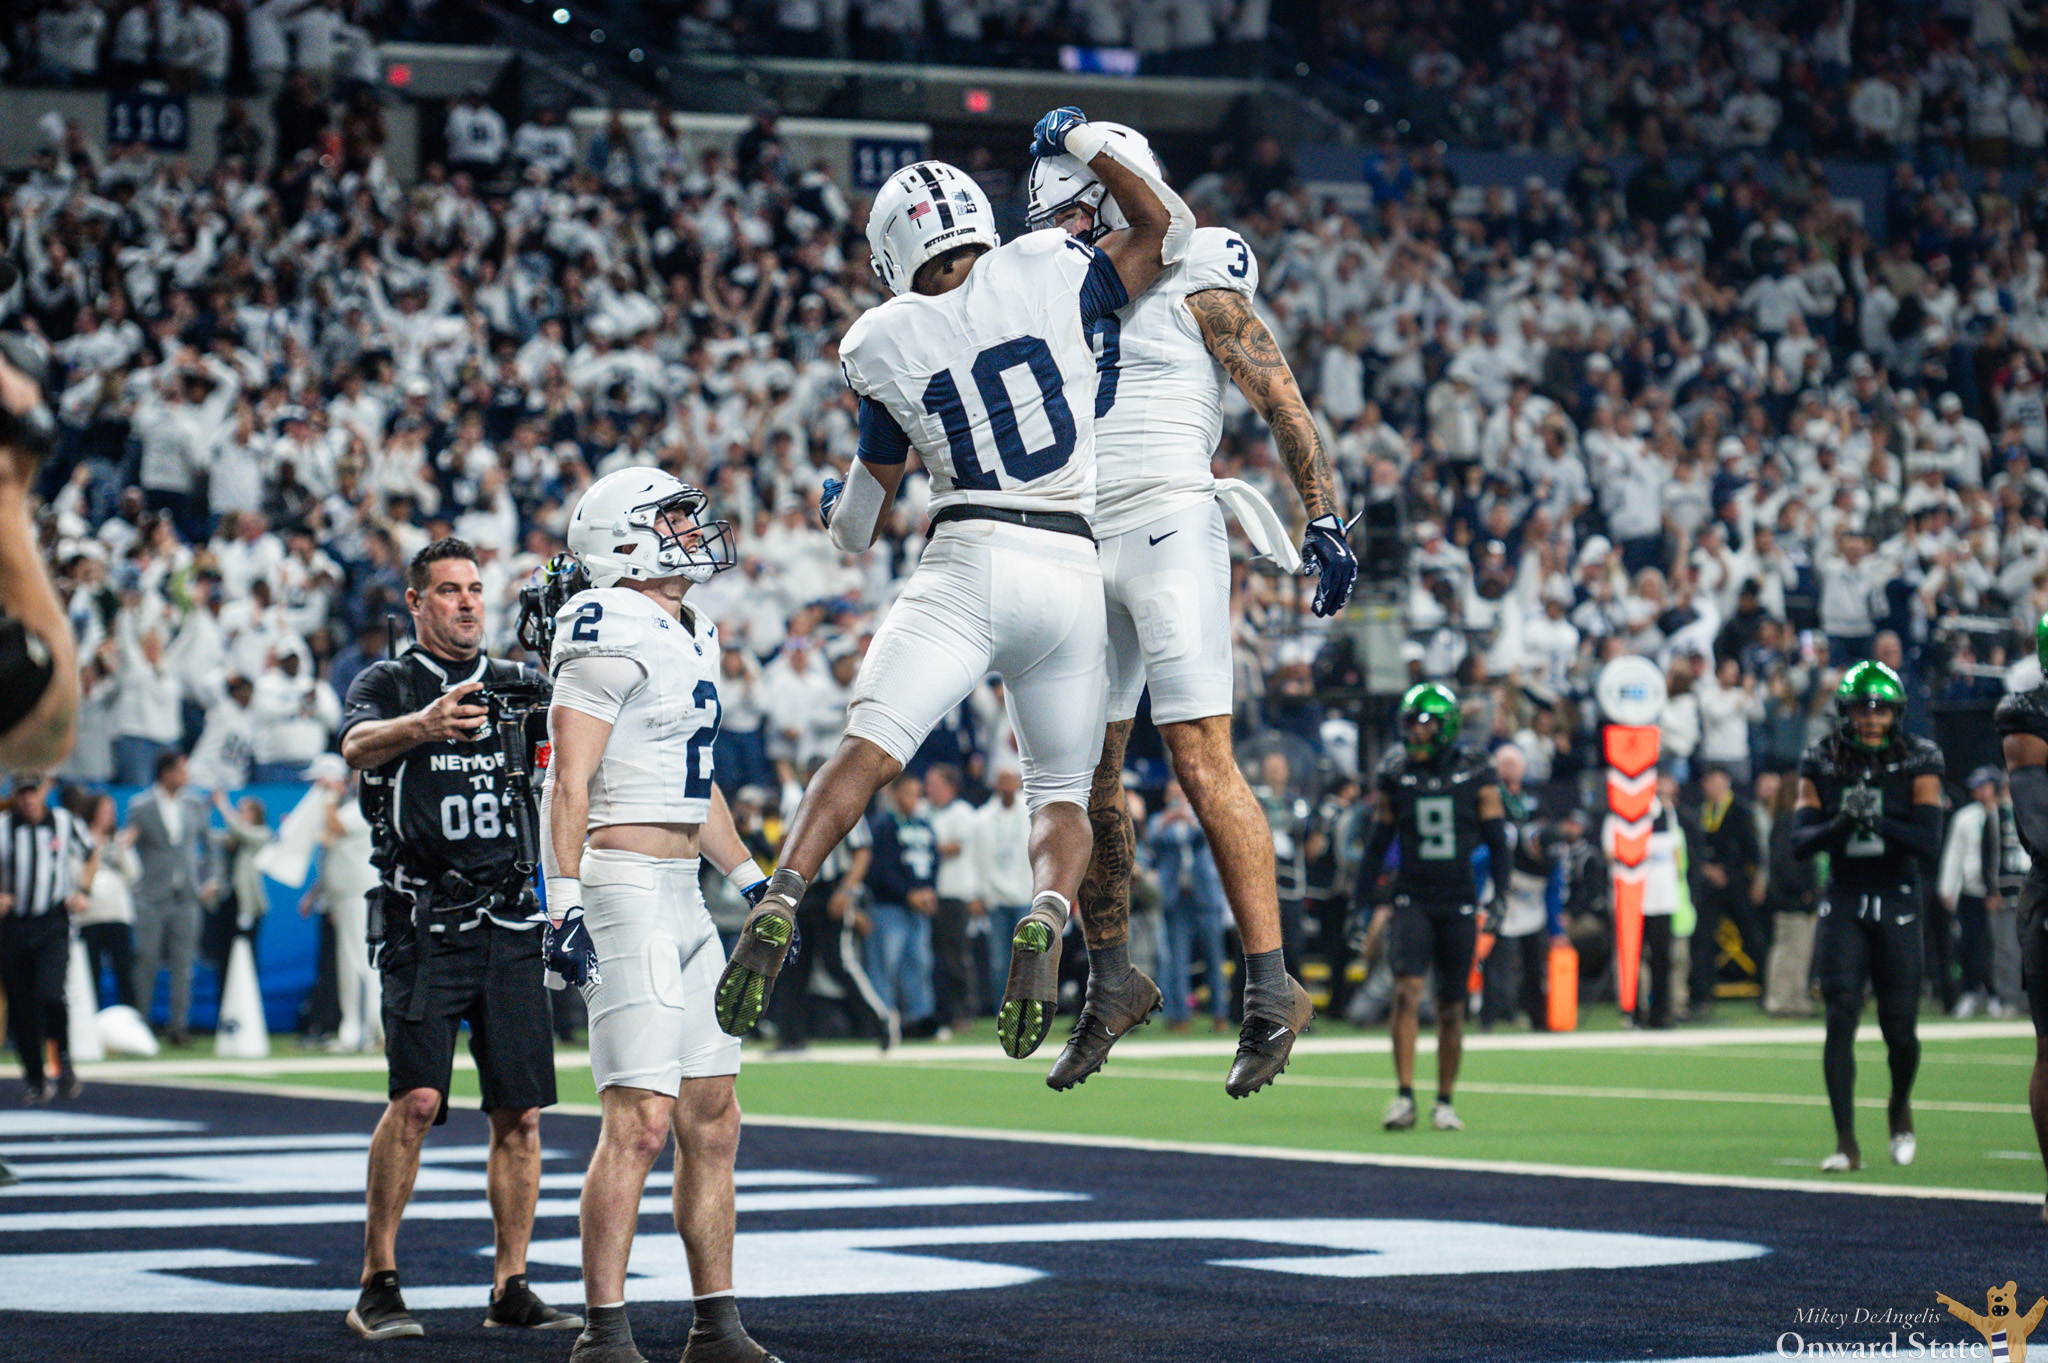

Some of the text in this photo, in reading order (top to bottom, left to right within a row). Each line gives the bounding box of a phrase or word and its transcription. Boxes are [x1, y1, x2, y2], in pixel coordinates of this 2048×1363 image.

[115, 102, 183, 141] 110
[924, 231, 955, 249] NITTANY
[1226, 238, 1249, 278] 3
[922, 335, 1077, 490] 10
[572, 602, 603, 642] 2
[684, 679, 722, 799] 2
[430, 752, 505, 772] NETWOR
[469, 774, 494, 790] TV
[1416, 796, 1457, 860] 9
